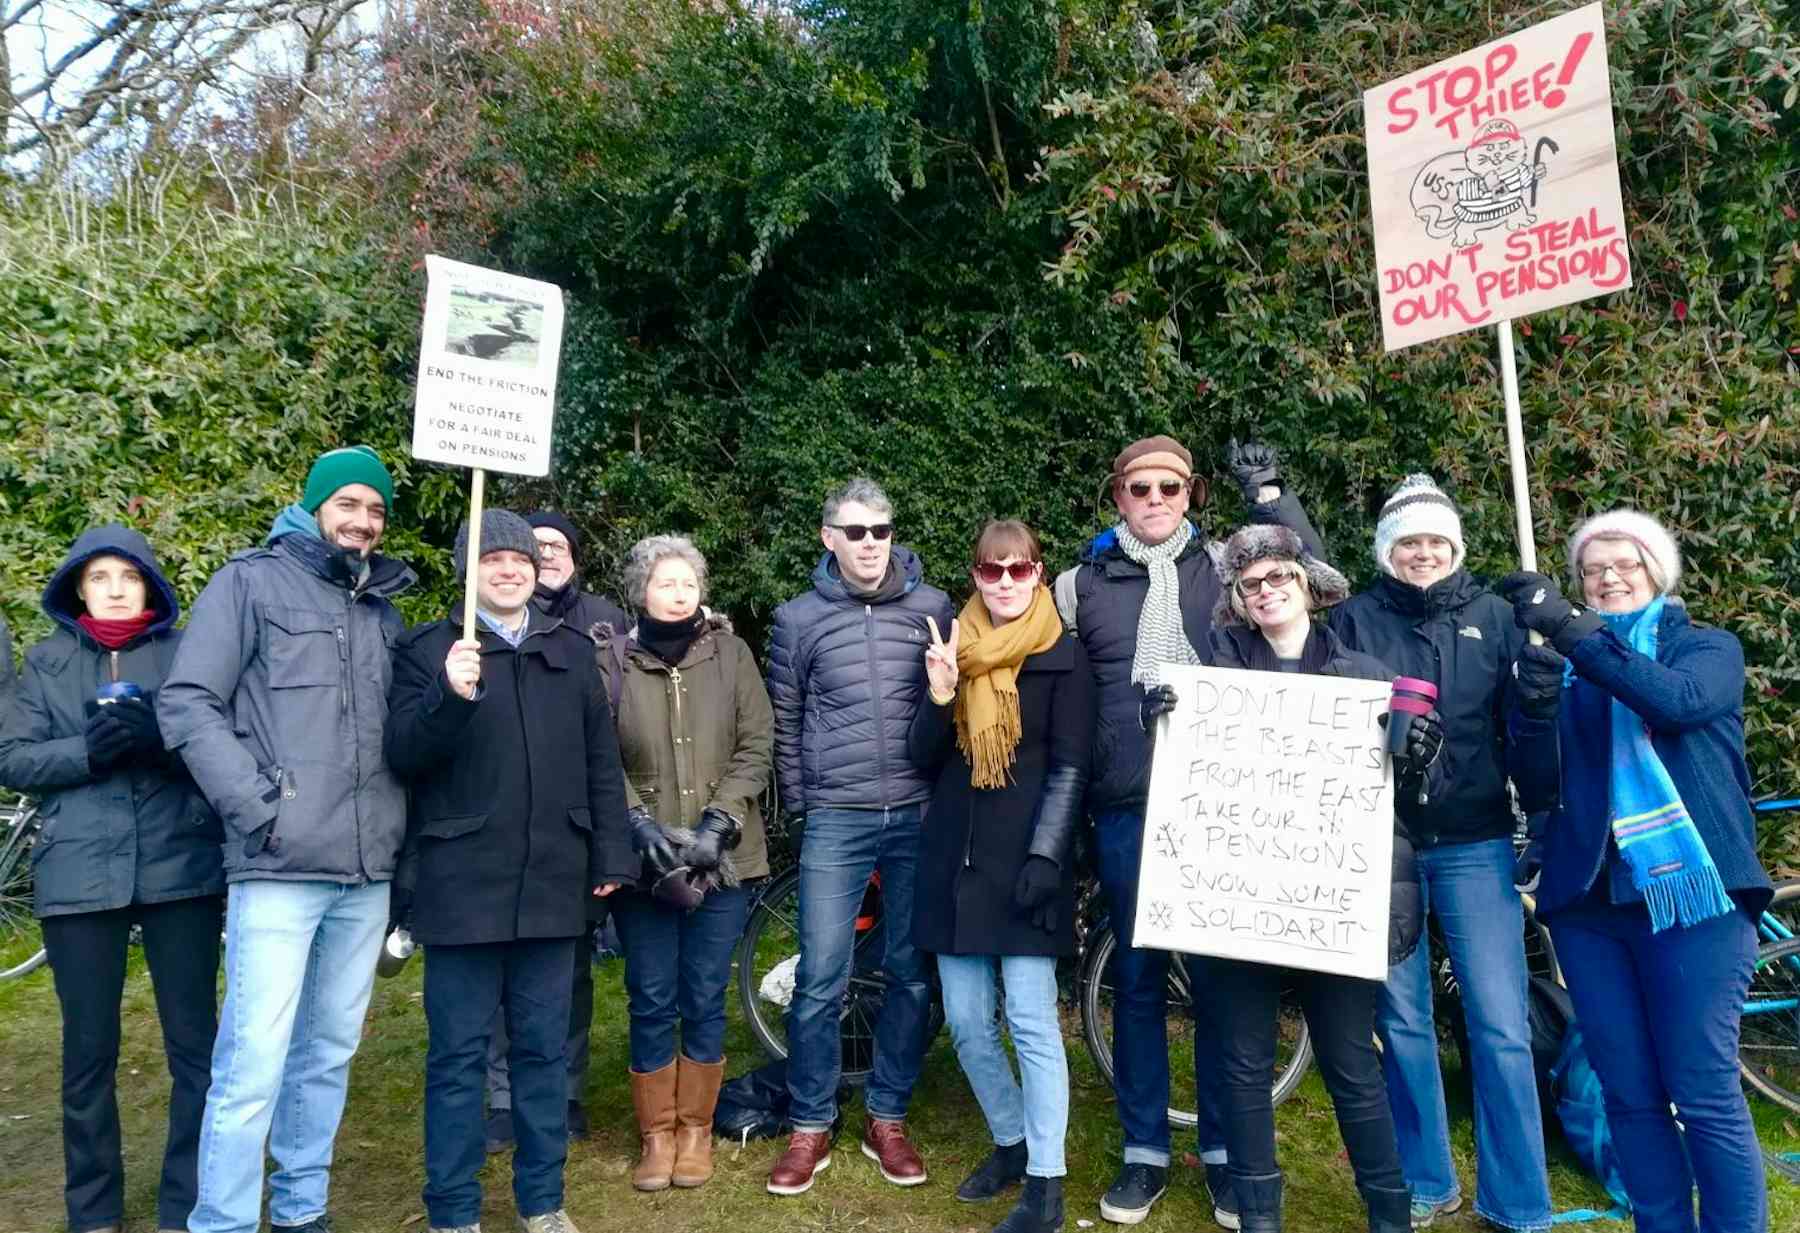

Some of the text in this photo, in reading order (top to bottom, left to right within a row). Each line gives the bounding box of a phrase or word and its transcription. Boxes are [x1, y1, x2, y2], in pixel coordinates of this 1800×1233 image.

[1387, 43, 1518, 135] STOP
[1435, 32, 1594, 140] THIEF!
[1423, 171, 1455, 201] USS
[1384, 207, 1616, 294] DON'T STEAL
[1393, 237, 1630, 326] OUR PENSIONS
[427, 366, 549, 398] END THE FRICTION
[428, 417, 538, 445] FOR A FAIR DEAL
[448, 401, 525, 422] NEGOTIATE
[438, 440, 527, 463] ON PENSIONS
[1308, 691, 1386, 730] LET
[1189, 718, 1241, 751] THE
[1188, 759, 1386, 812] FROM THE EAST
[1181, 793, 1306, 832] TAKE OUR
[1206, 826, 1368, 874] PENSIONS
[1180, 864, 1360, 912] SNOW SOME
